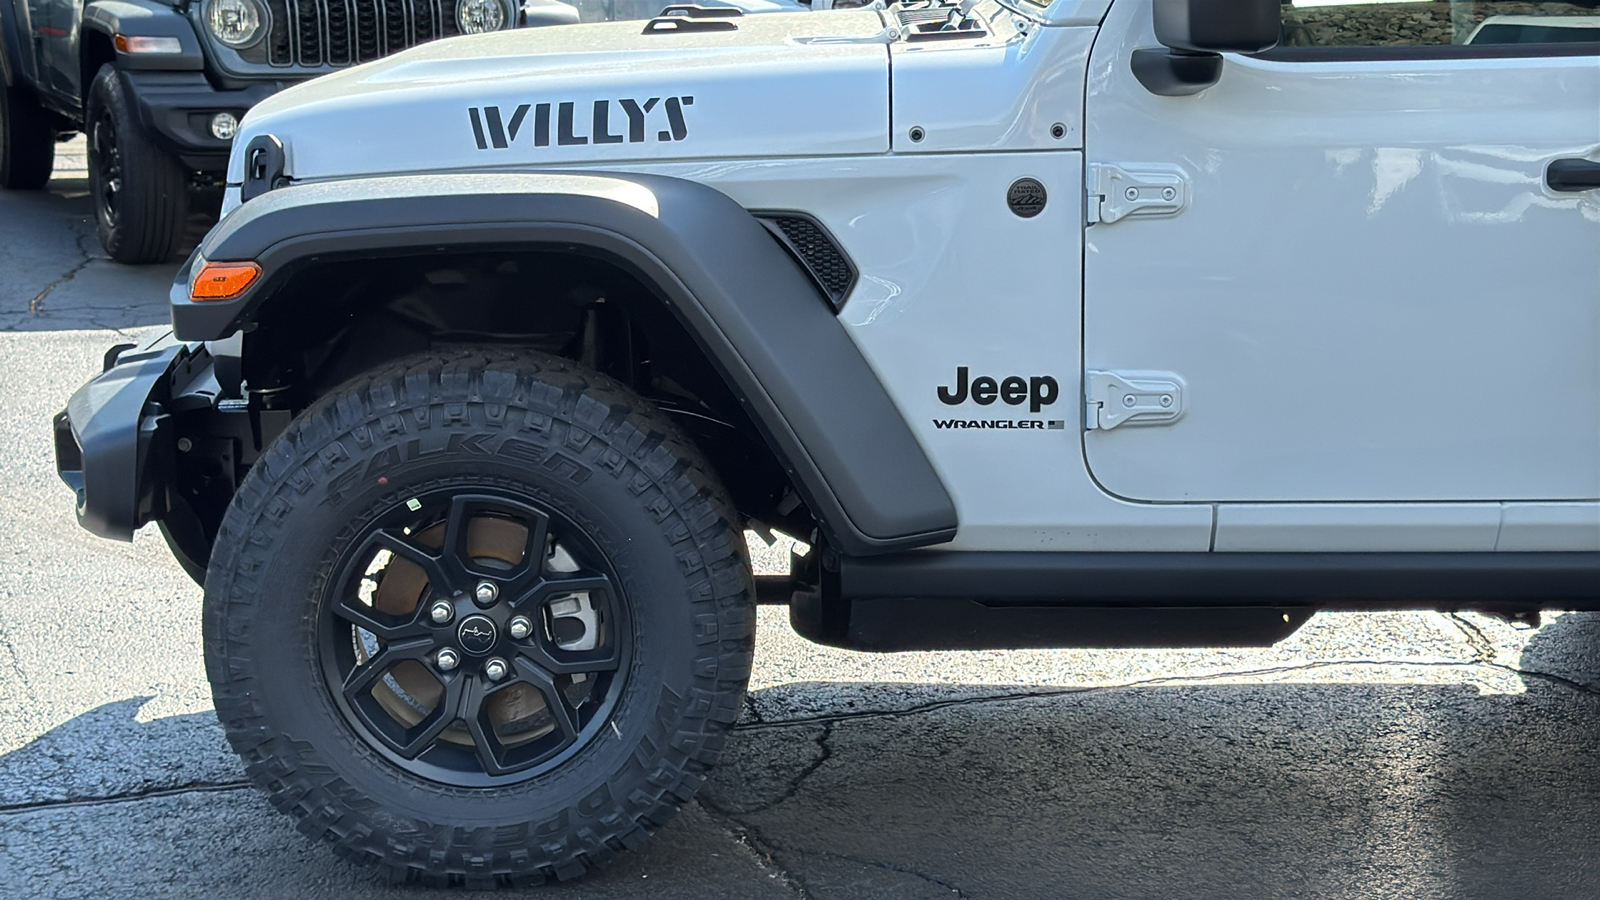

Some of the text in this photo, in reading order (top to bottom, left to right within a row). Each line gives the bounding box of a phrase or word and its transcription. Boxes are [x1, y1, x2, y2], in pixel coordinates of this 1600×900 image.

[468, 96, 694, 150] WILLYS
[937, 366, 1059, 413] Jeep
[933, 419, 1044, 429] WRANGLER
[319, 432, 593, 507] FALKEN
